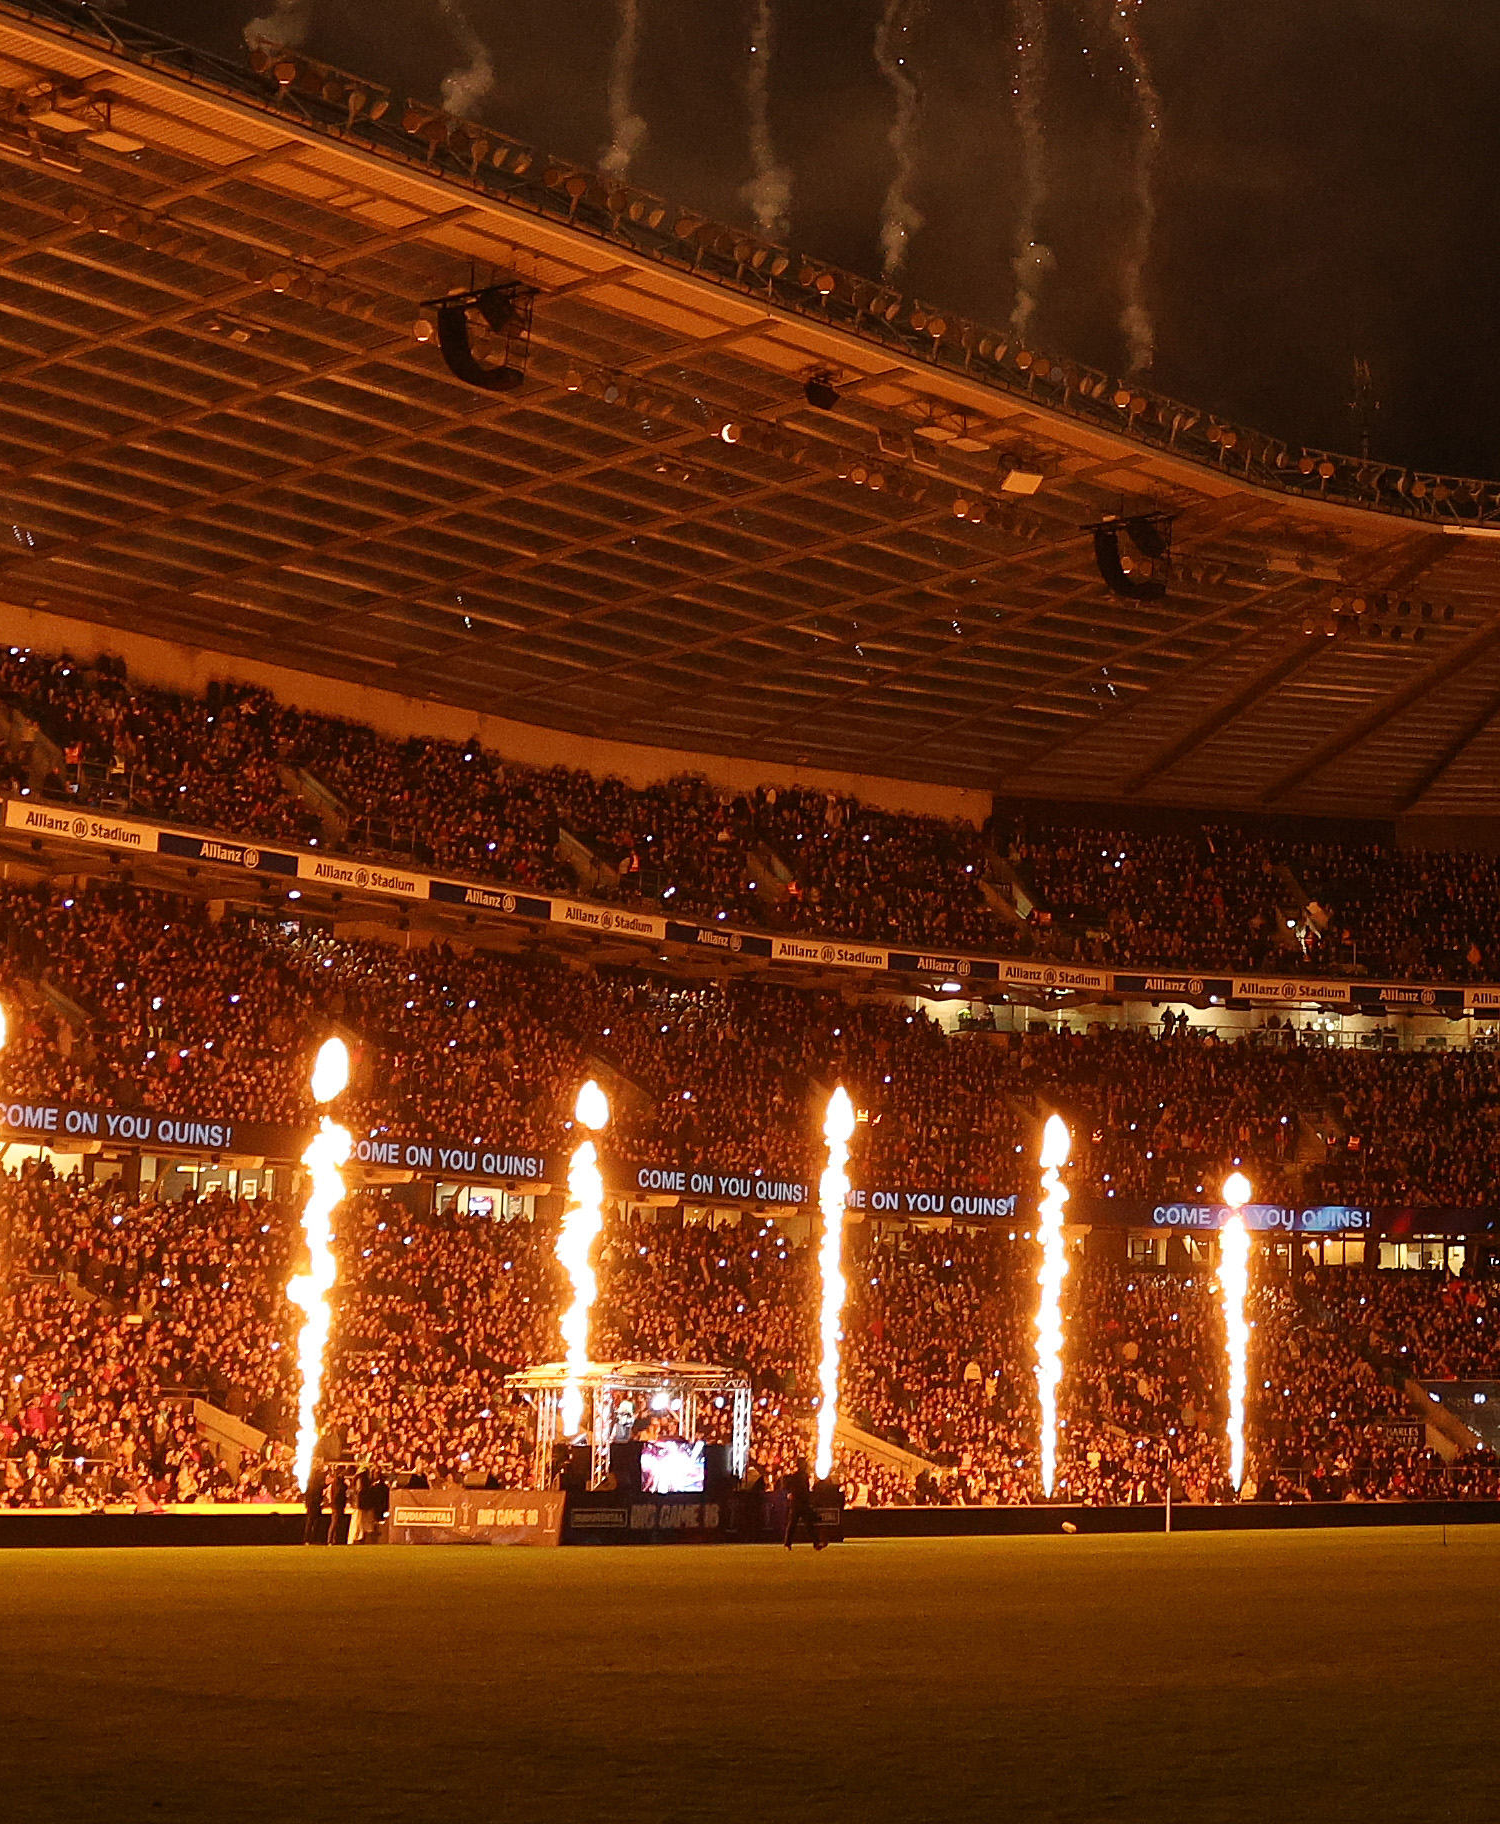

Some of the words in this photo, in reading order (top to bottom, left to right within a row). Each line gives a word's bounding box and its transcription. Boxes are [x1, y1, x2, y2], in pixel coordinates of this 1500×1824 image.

[25, 810, 70, 832] Allianz
[90, 823, 141, 845] Stadium
[200, 842, 242, 863] Allianz
[315, 862, 353, 882] Allianz
[370, 873, 416, 893] Stadium
[465, 889, 501, 908] Allianz
[565, 906, 599, 925] Allianz
[614, 916, 653, 934] Stadium
[697, 929, 729, 947] Allianz
[779, 943, 819, 959] Allianz
[837, 949, 883, 965] Stadium
[917, 956, 955, 974] Allianz
[1005, 966, 1042, 982] Allianz
[1059, 971, 1101, 987] Stadium
[1144, 978, 1186, 992] Allianz
[1238, 982, 1280, 995] Allianz
[1299, 985, 1346, 999] Stadium
[1379, 988, 1419, 1002] Allianz
[65, 1110, 98, 1134] ON
[105, 1114, 150, 1139] YOU
[157, 1120, 232, 1147] QUINS!
[405, 1147, 432, 1168] ON
[438, 1149, 477, 1172] YOU
[481, 1153, 544, 1179] QUINS!
[638, 1168, 686, 1191] COME
[690, 1175, 714, 1194] ON
[718, 1177, 751, 1198] YOU
[755, 1180, 809, 1203] QUINS!
[871, 1192, 899, 1210] ON
[905, 1194, 944, 1212] YOU
[950, 1195, 1016, 1217] QUINS!
[1153, 1206, 1211, 1226] COME
[1255, 1209, 1295, 1231] YOU
[1301, 1210, 1371, 1228] QUINS!
[496, 1509, 524, 1525] GAME
